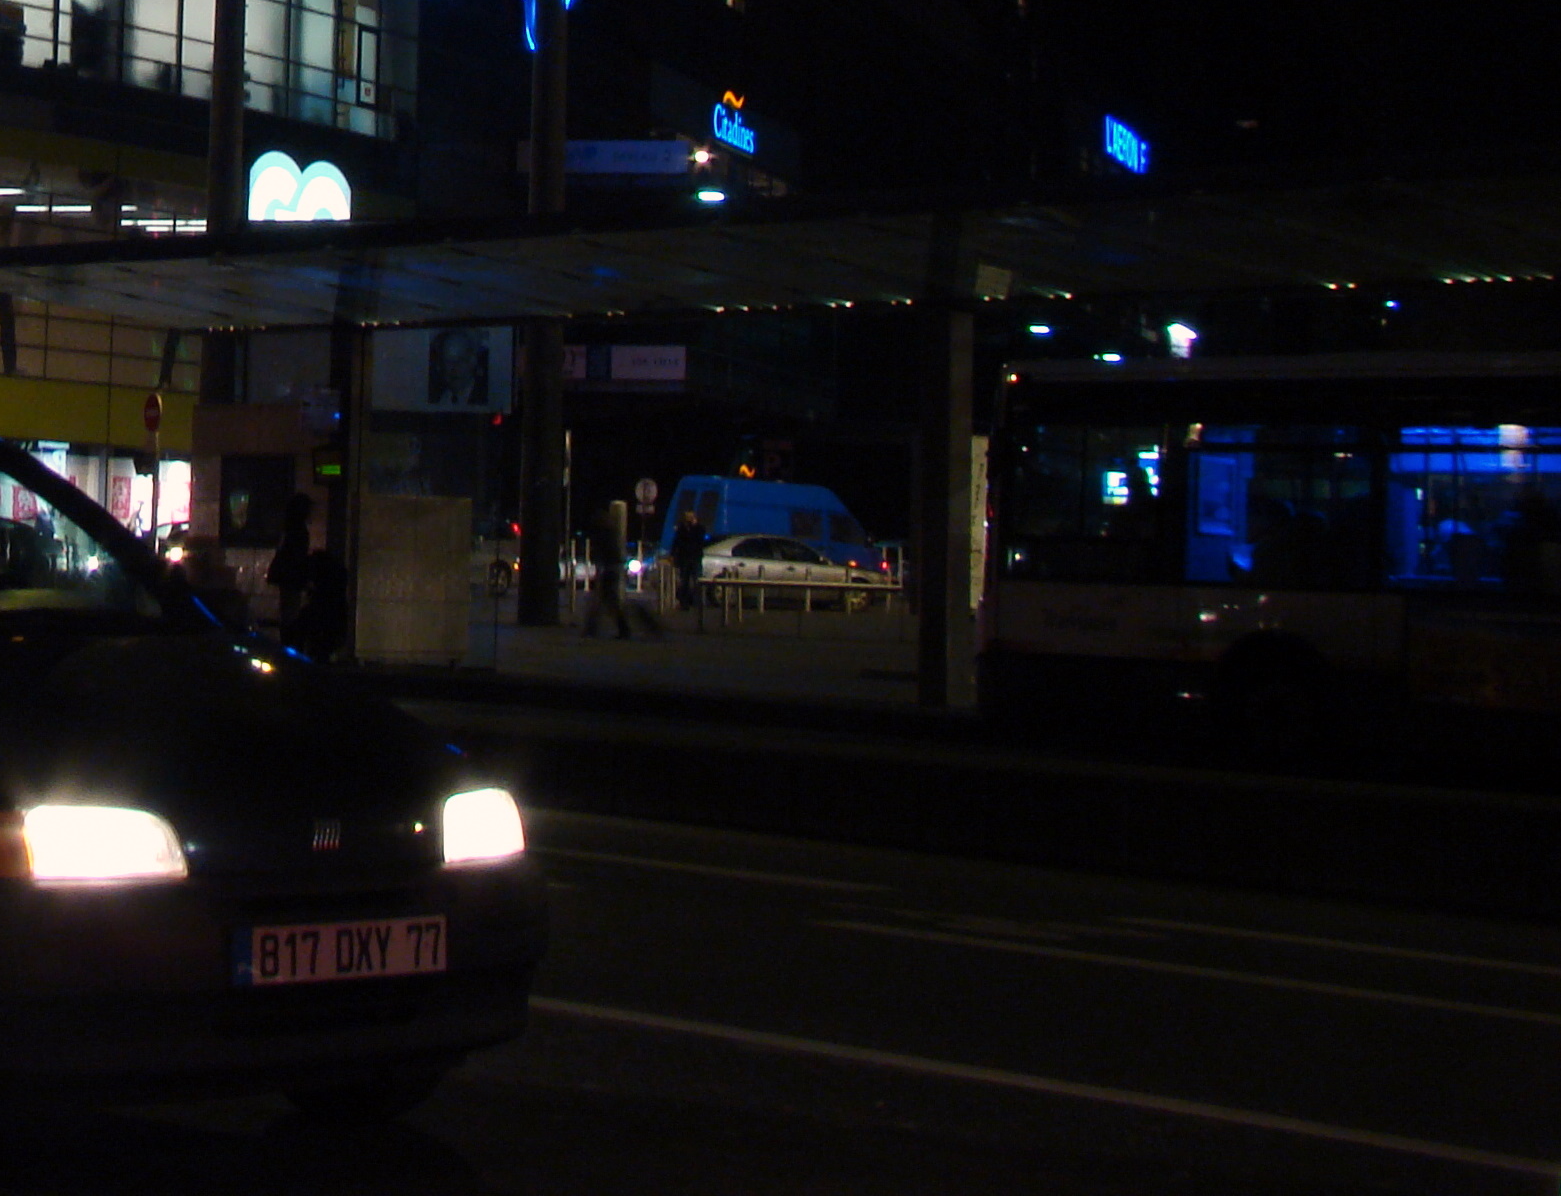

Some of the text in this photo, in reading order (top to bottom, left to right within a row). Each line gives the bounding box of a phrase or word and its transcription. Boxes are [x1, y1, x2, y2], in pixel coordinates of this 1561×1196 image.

[713, 102, 755, 154] Citadines
[260, 922, 441, 978] 817 DXY 77
